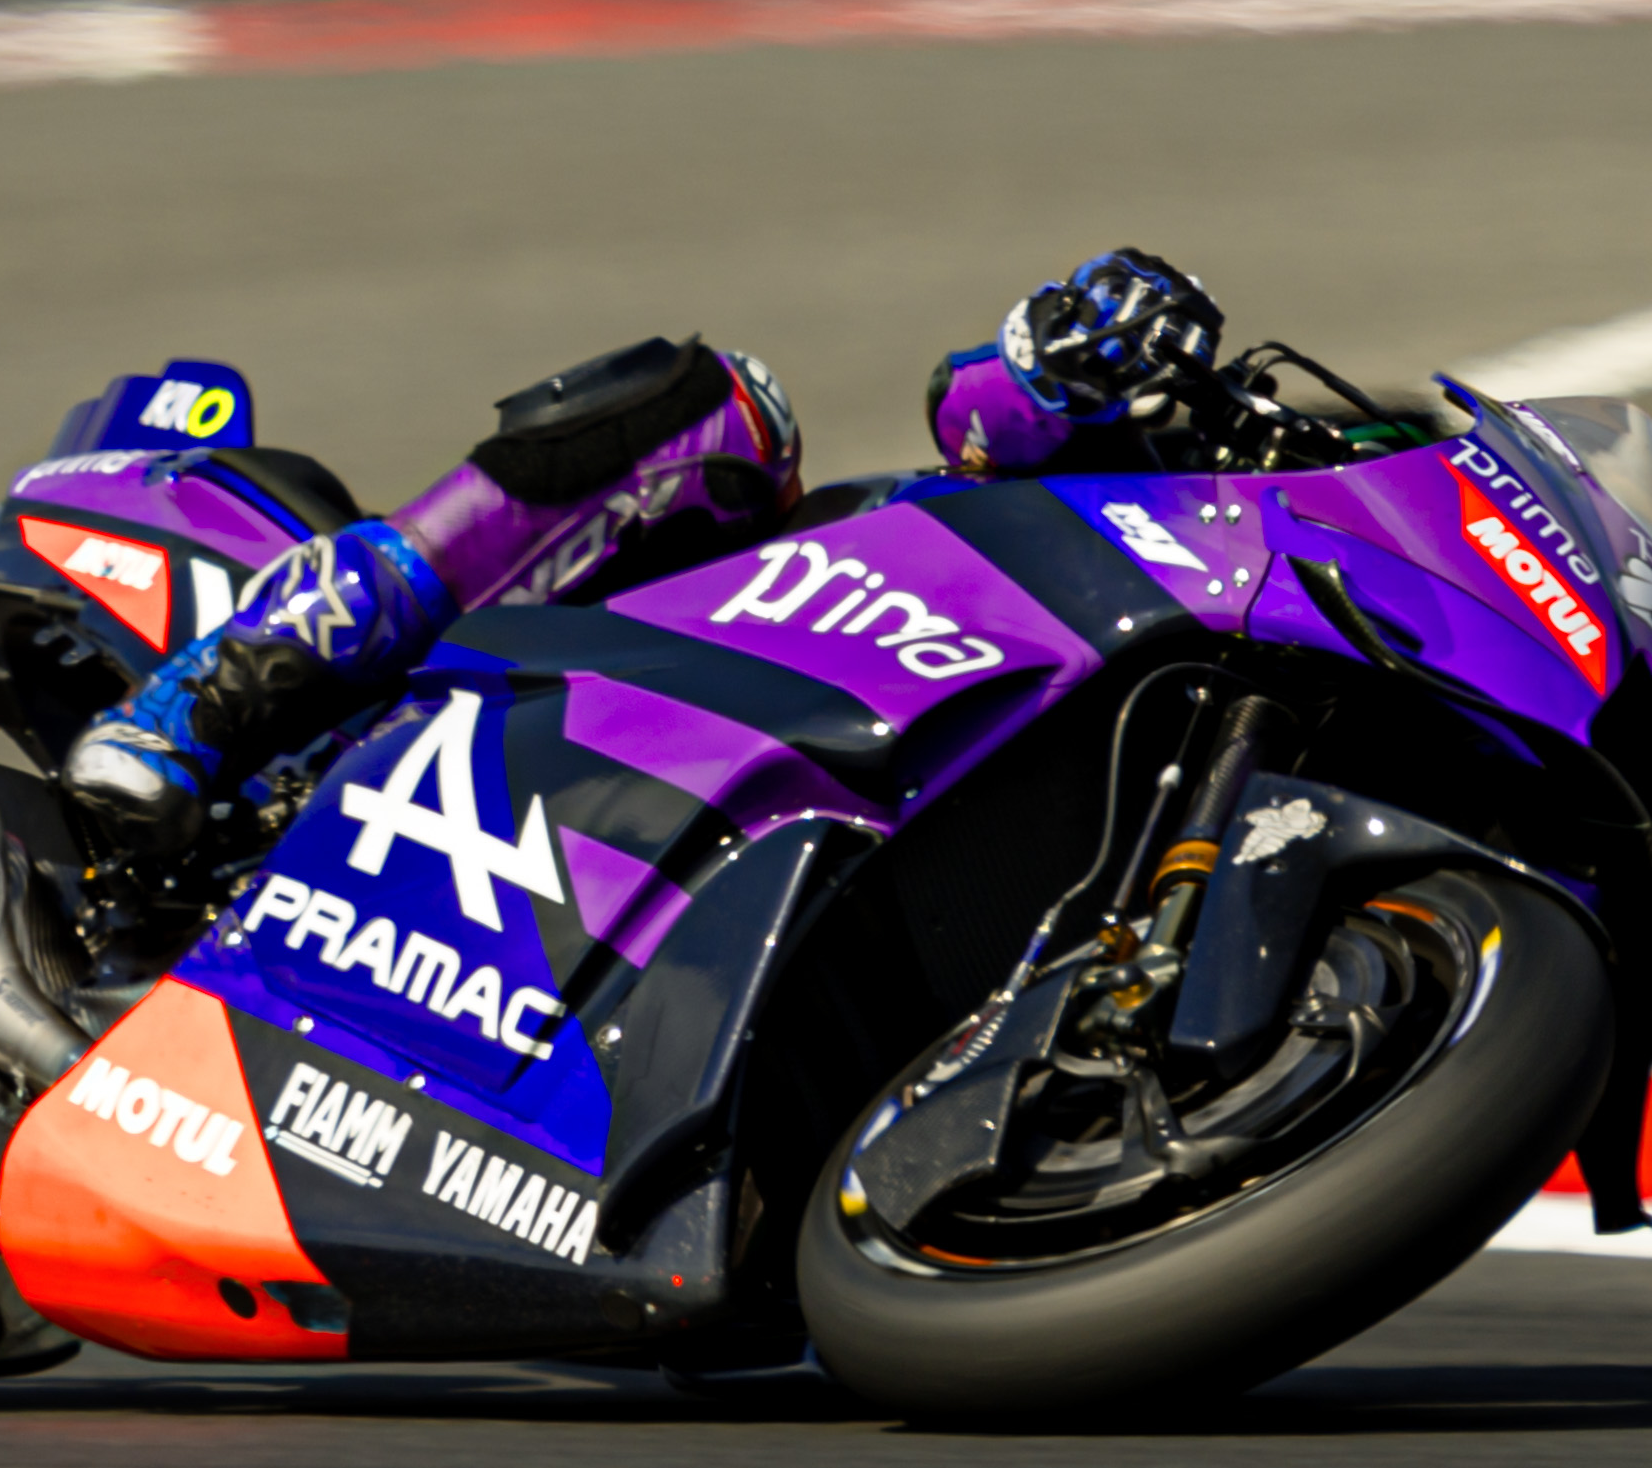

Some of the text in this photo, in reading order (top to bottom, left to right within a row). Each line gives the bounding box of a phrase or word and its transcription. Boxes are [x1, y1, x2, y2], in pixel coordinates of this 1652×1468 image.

[1449, 435, 1602, 586] prima
[708, 540, 1005, 680] prima
[1465, 515, 1603, 657] MOTUL
[241, 873, 561, 1061] PRAMAC
[67, 1056, 245, 1177] MOTUL
[269, 1061, 413, 1176] FIAMM
[420, 1129, 600, 1267] YAMAHA
